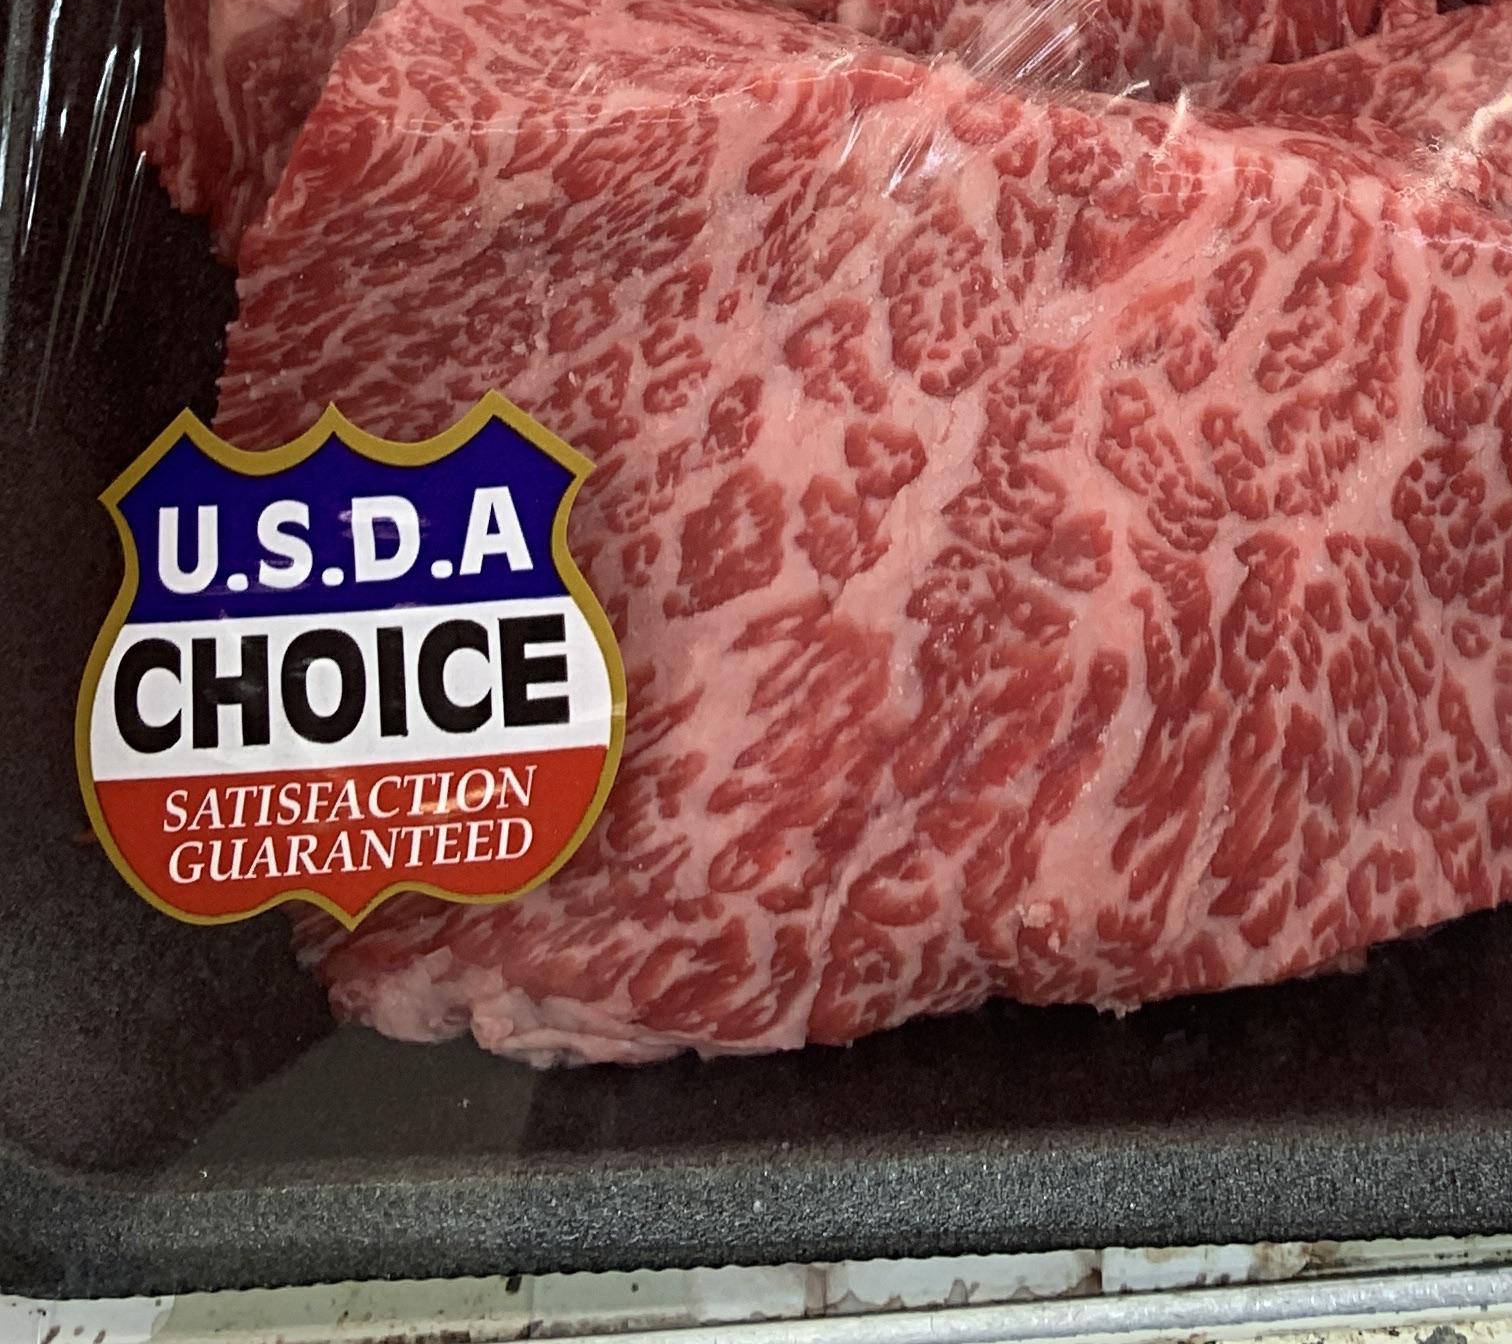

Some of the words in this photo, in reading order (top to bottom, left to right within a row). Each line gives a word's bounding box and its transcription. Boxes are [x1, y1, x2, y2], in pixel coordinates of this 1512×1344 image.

[158, 486, 533, 594] U.S.D.A
[113, 614, 570, 754] CHOICE
[162, 765, 537, 832] SATISFACTION
[167, 818, 533, 884] GUARANTEED
